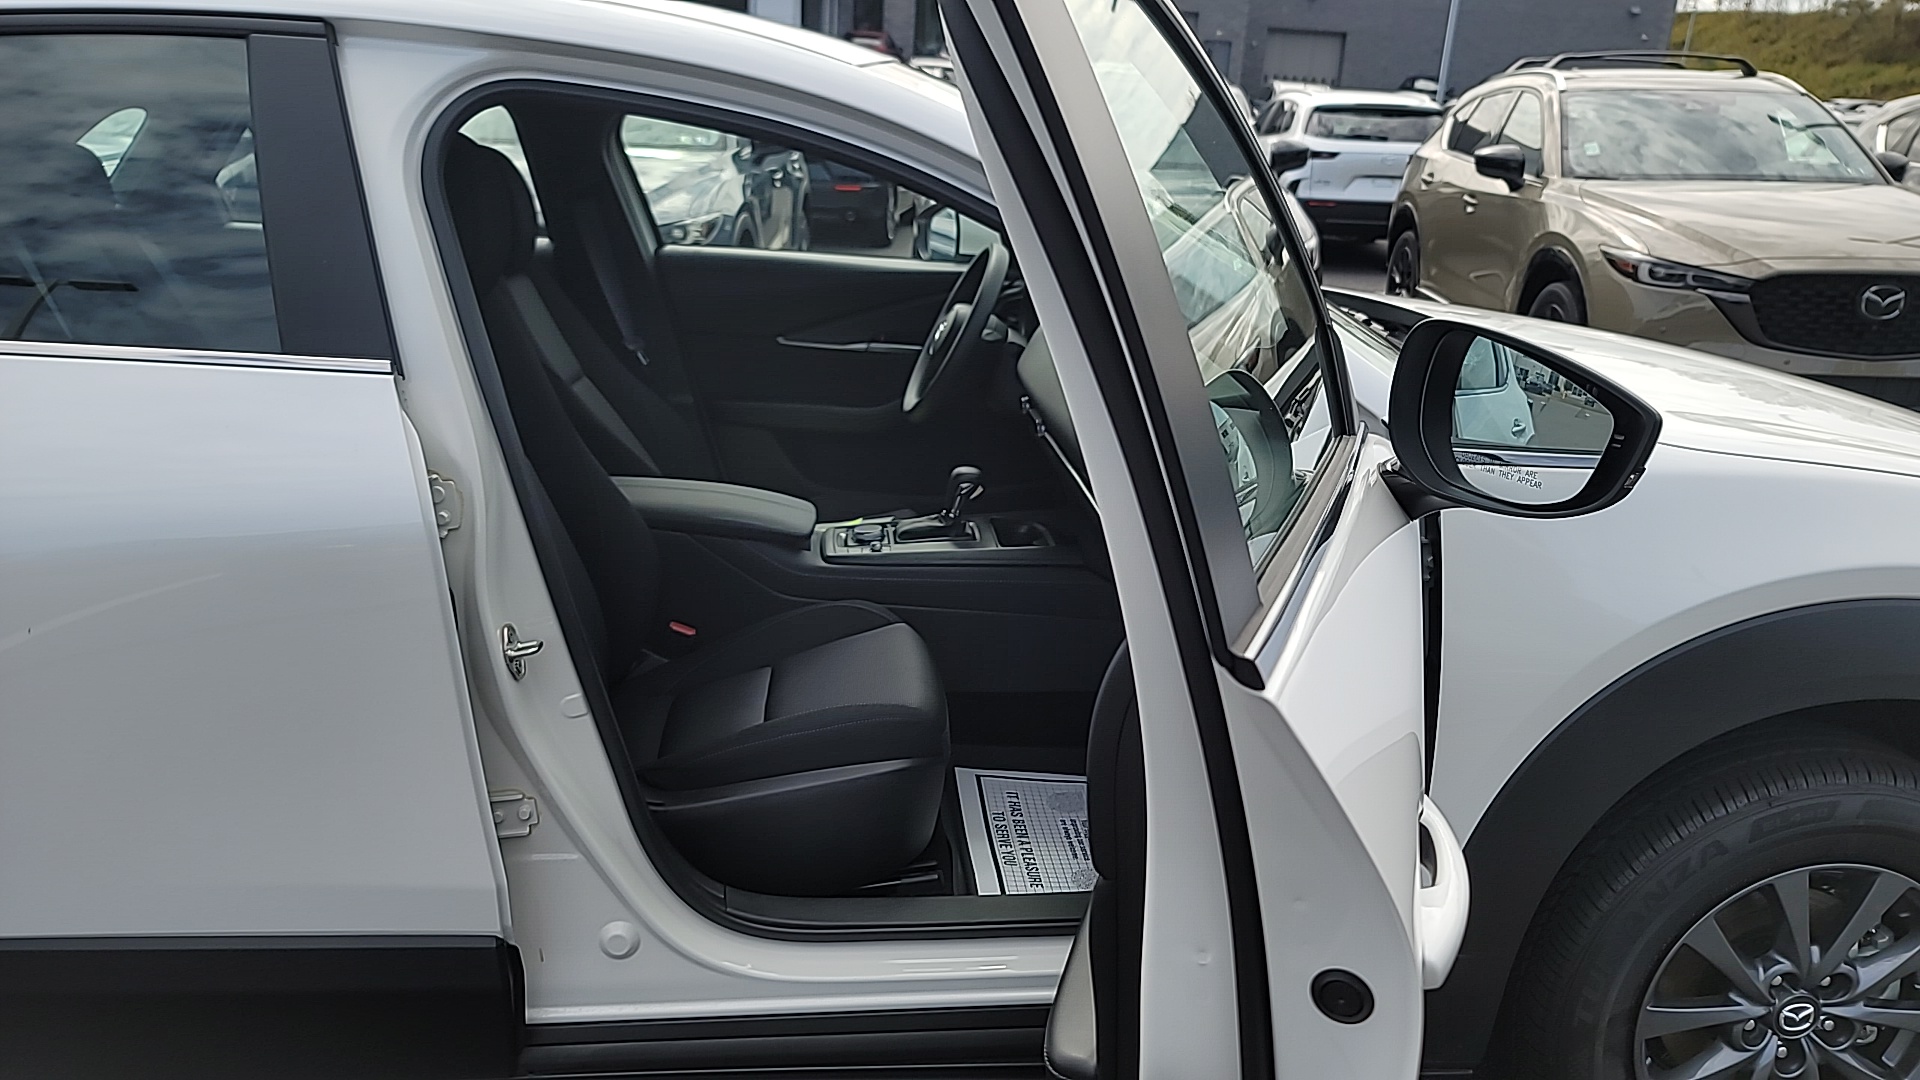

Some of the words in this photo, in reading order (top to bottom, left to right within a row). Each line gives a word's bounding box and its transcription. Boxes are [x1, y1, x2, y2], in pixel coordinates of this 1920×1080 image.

[1480, 465, 1496, 475] THAN
[1498, 469, 1515, 481] THEY
[1516, 475, 1543, 490] APPEAR
[1524, 469, 1539, 480] ARE
[1005, 791, 1020, 800] IT
[991, 811, 1006, 822] TO
[1007, 800, 1024, 817] HAS
[994, 823, 1013, 849] SERVE
[1012, 819, 1030, 839] BEEN
[1000, 849, 1018, 866] YOU
[1020, 847, 1044, 889] PLEASURE
